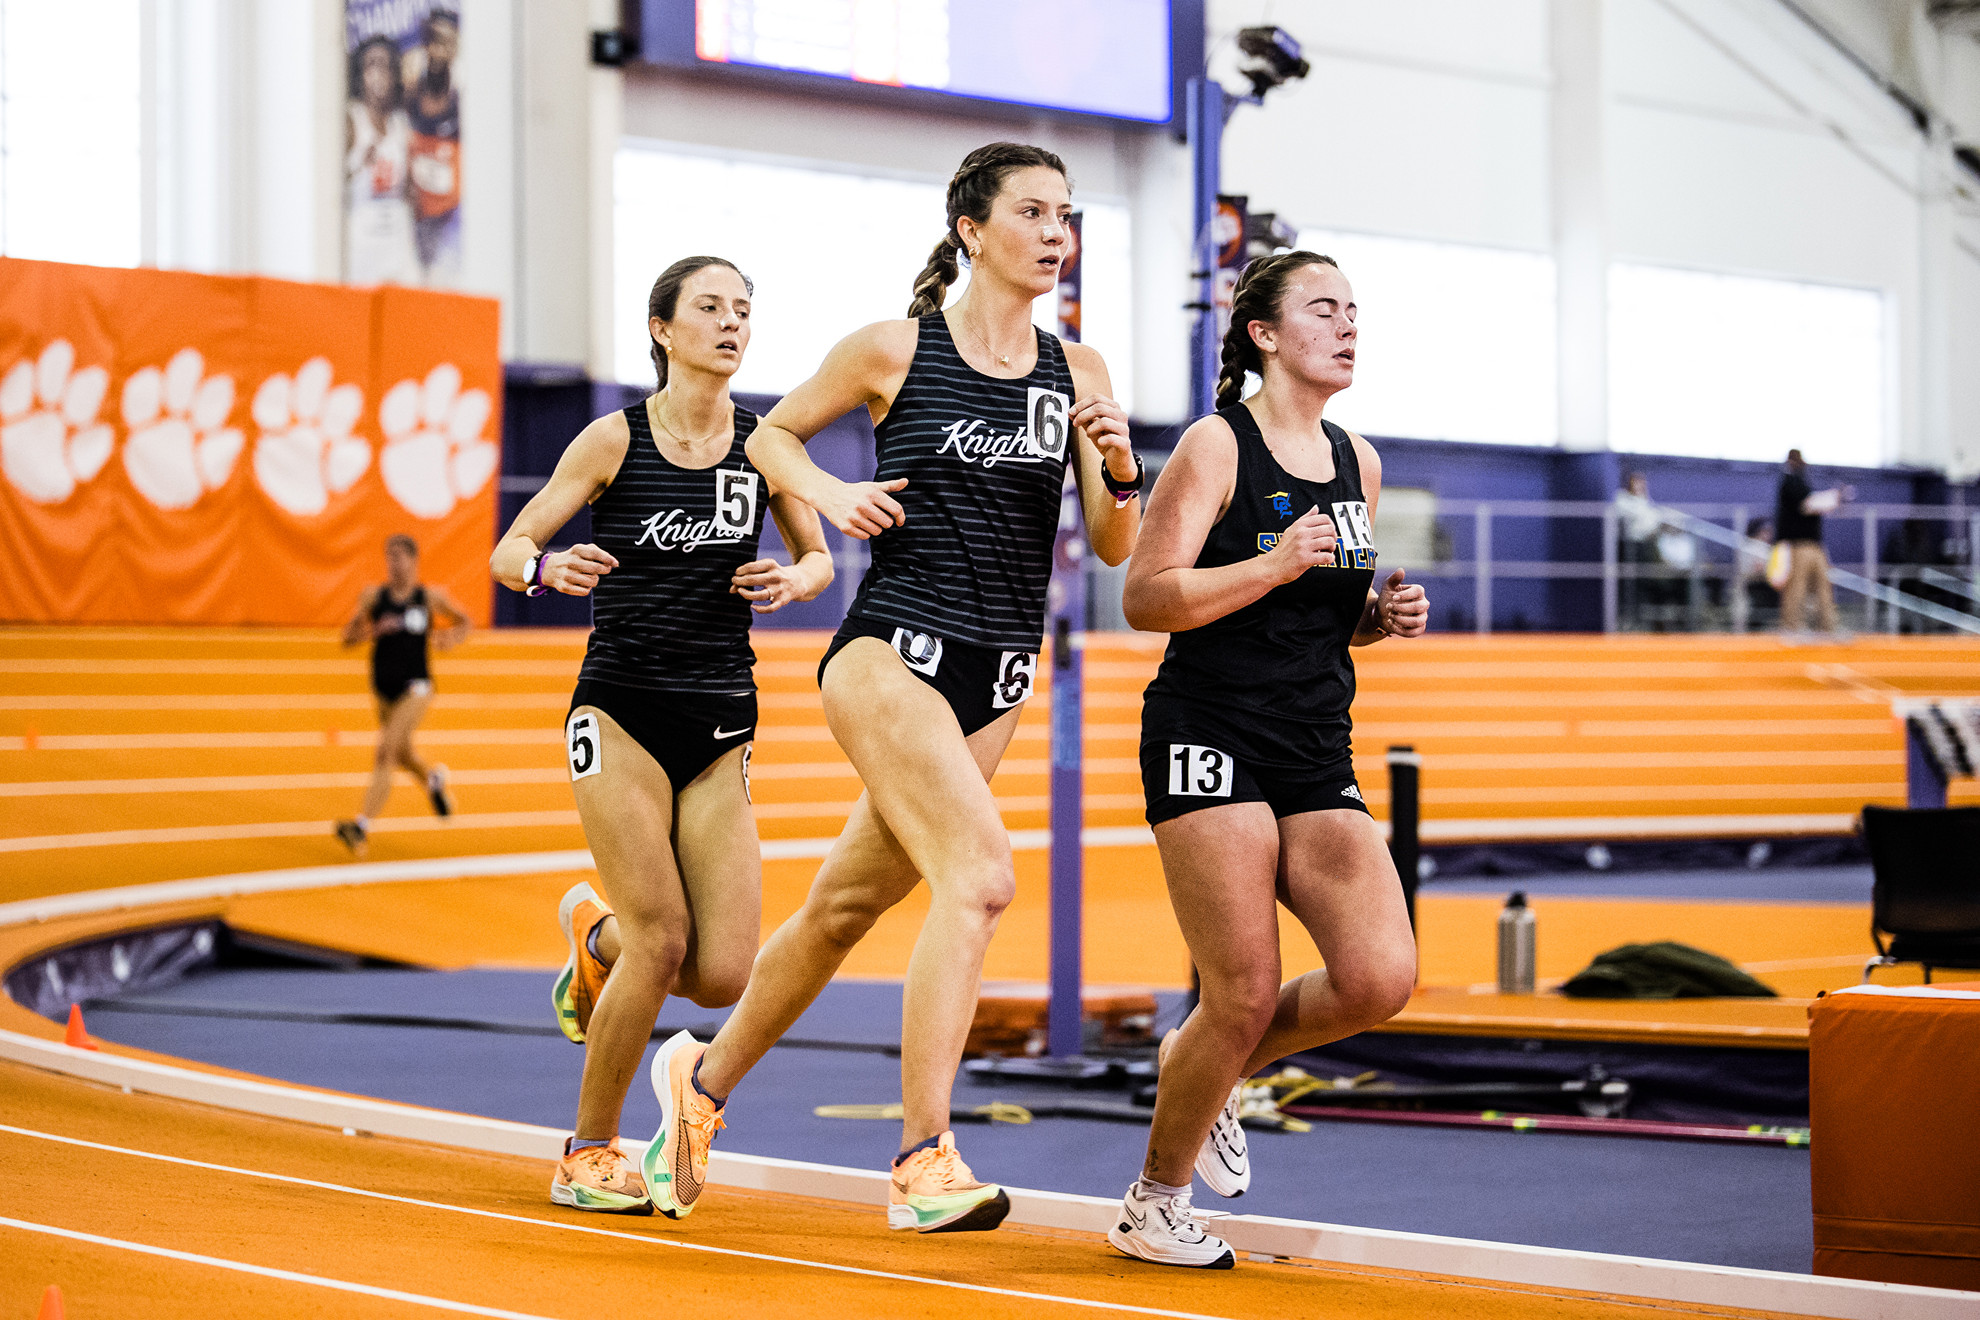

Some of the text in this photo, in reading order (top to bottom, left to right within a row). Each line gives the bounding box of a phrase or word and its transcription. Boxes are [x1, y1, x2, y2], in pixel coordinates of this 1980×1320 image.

[1034, 393, 1064, 454] 6
[722, 474, 750, 528] 5
[1338, 503, 1373, 547] 13
[572, 717, 594, 774] 5
[1174, 746, 1224, 794] 13
